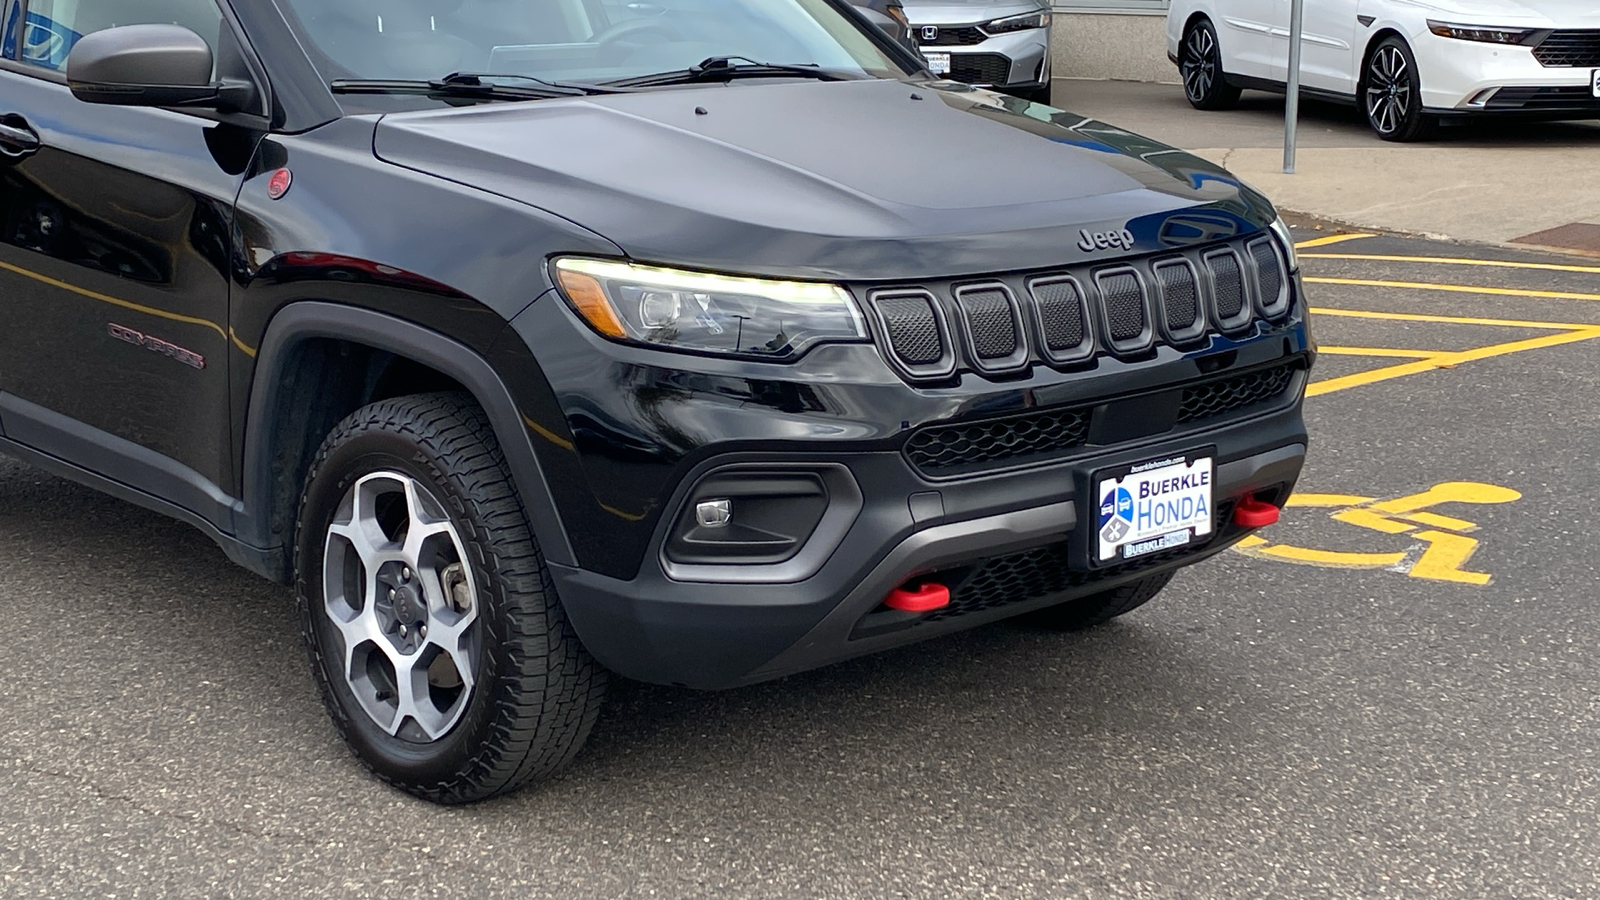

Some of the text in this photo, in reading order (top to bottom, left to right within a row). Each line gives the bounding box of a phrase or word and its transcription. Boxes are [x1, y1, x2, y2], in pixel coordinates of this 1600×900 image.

[1078, 228, 1135, 253] Jeep
[107, 322, 206, 370] COMPASS
[1131, 456, 1186, 473] buerklehonda.com
[1139, 471, 1209, 499] BUERKLE
[1138, 494, 1208, 531] HONDA
